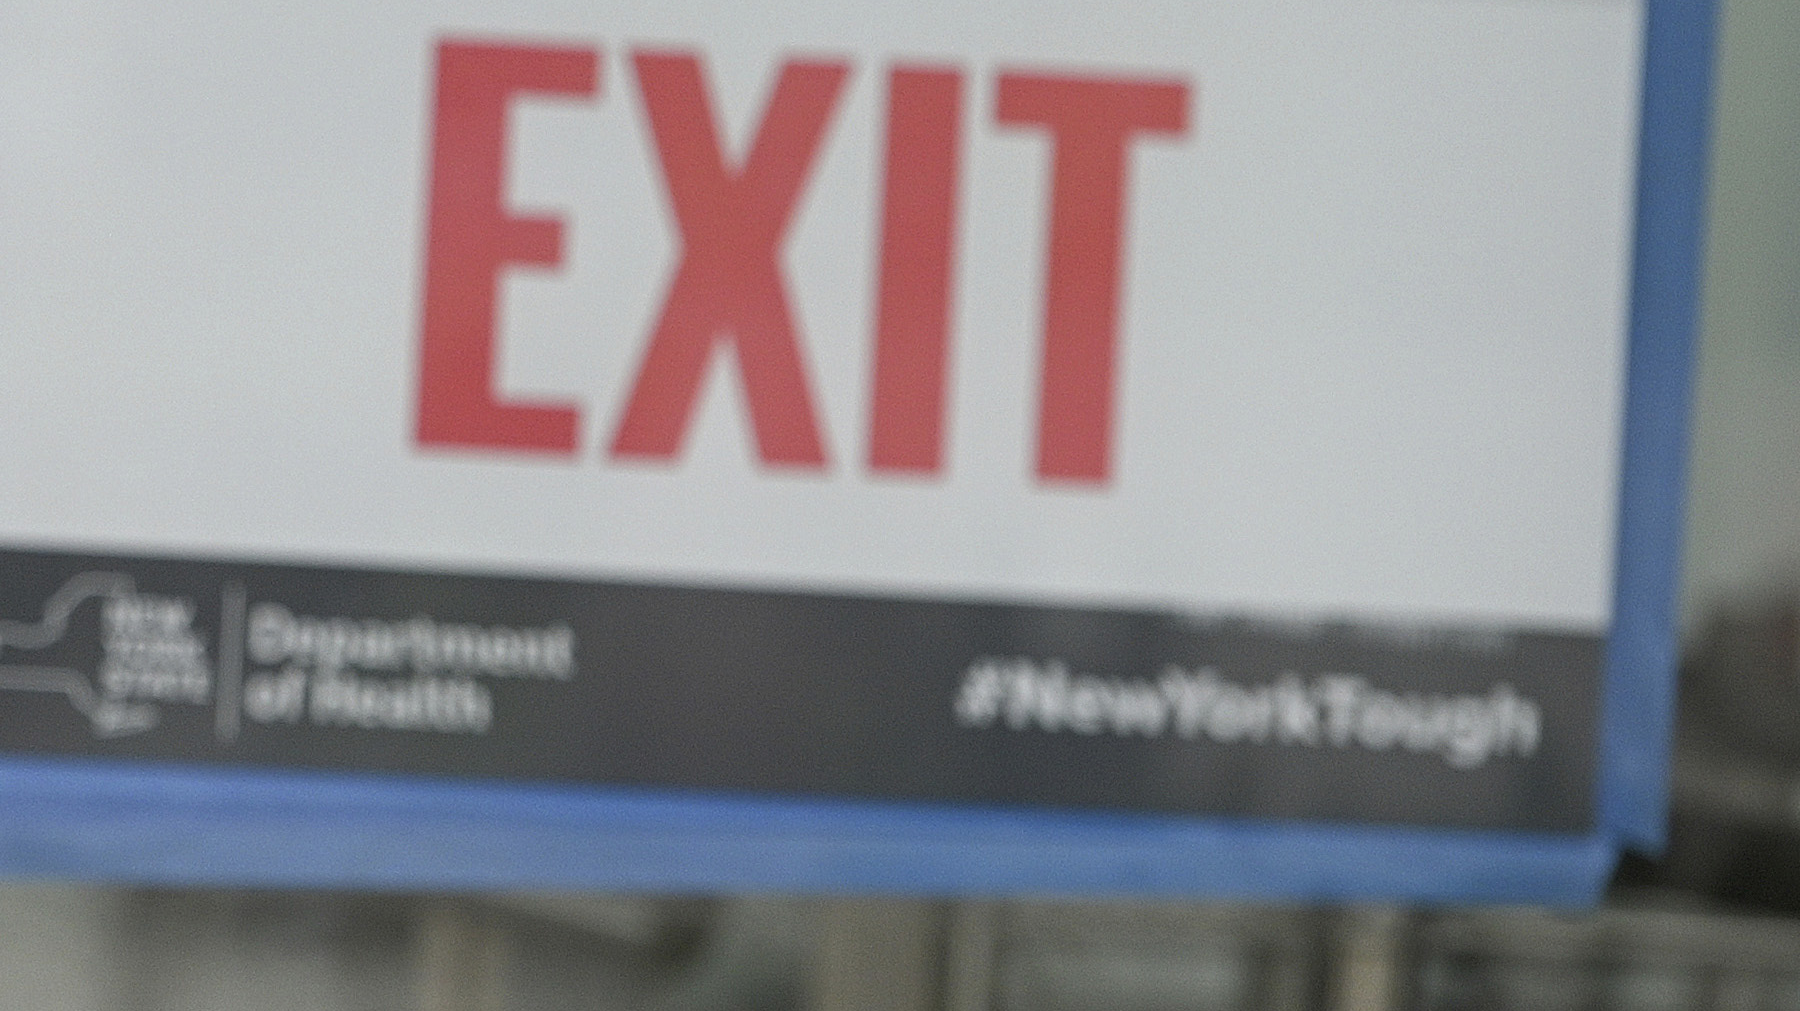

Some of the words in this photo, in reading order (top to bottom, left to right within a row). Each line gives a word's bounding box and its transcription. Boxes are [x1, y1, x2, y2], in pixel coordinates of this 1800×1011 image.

[412, 34, 1192, 488] EXIT
[246, 601, 575, 681] Department
[244, 665, 305, 725] of
[308, 672, 492, 734] Health
